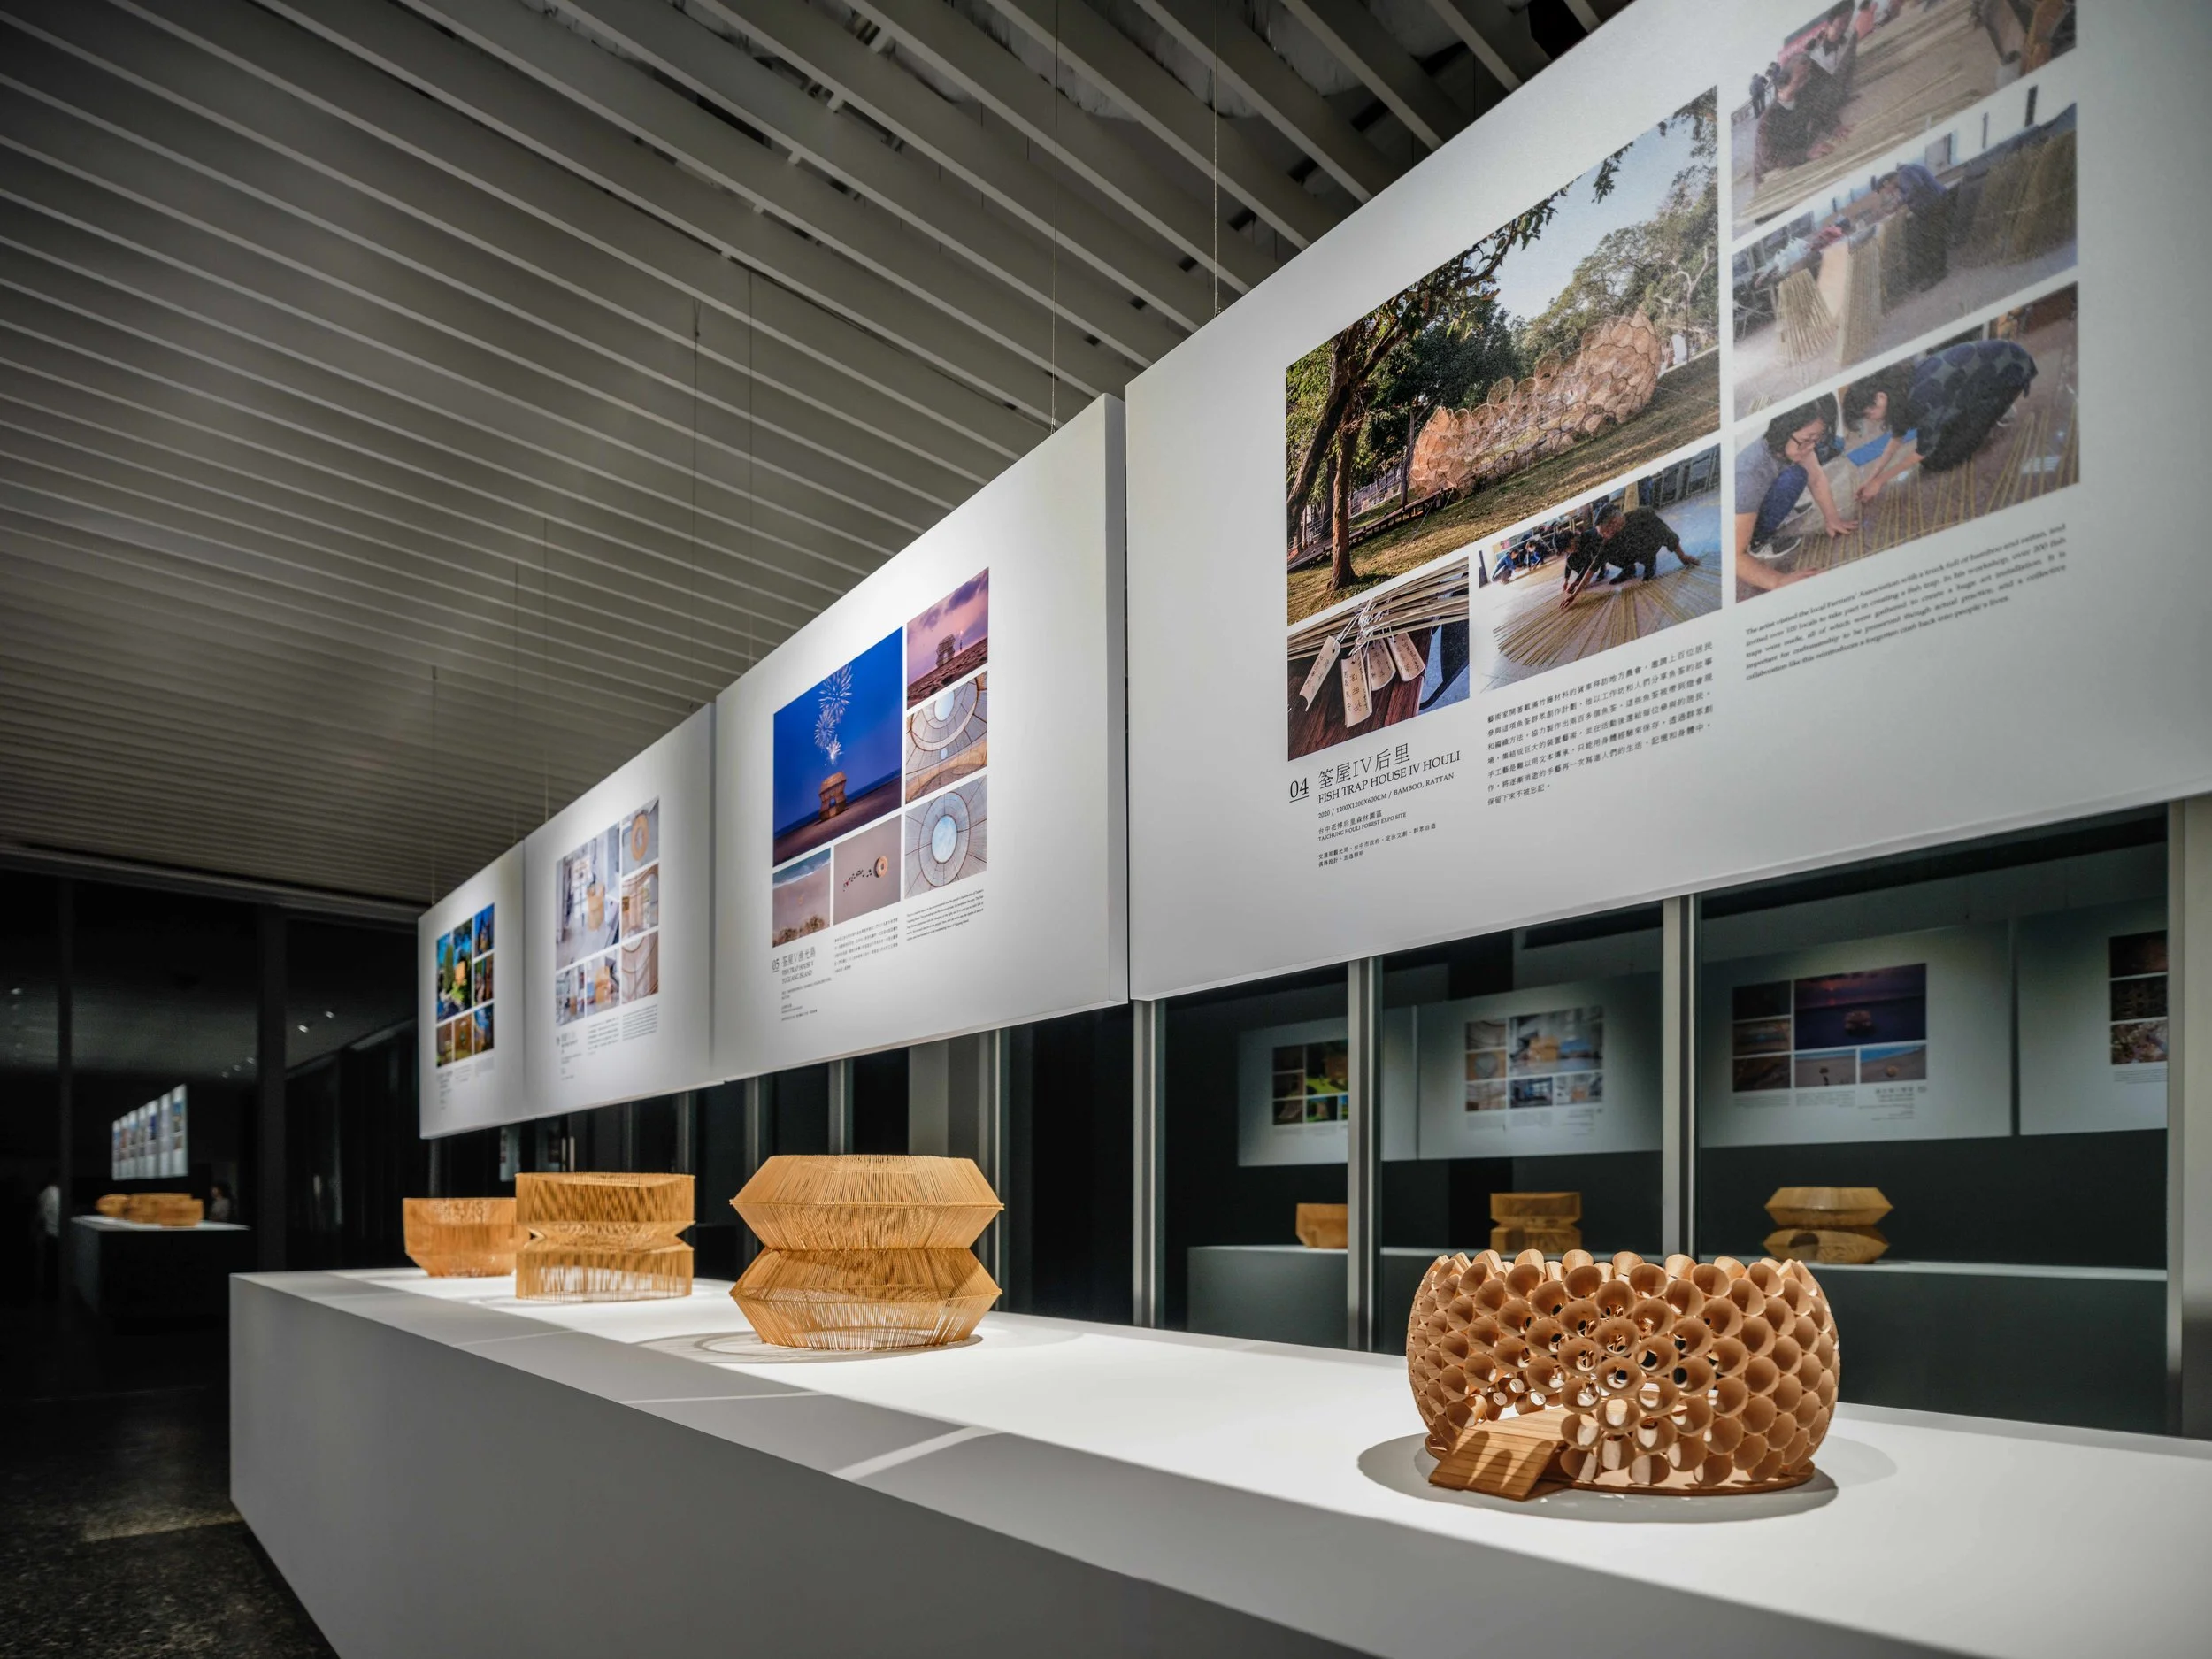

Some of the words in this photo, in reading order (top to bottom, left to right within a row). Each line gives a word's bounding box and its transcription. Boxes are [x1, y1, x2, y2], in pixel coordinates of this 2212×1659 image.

[1901, 573, 1917, 583] with
[1925, 565, 1944, 575] truck
[2003, 540, 2019, 549] and
[2049, 524, 2066, 534] and
[1830, 619, 1850, 630] which
[1855, 614, 1870, 623] were
[1875, 602, 1907, 618] gathered
[1922, 591, 1944, 602] create
[1957, 581, 1976, 590] huge
[1845, 605, 1859, 616] part
[1870, 593, 1899, 605] creating
[1865, 616, 1901, 634] preserved
[1935, 598, 1957, 610] actual
[1999, 580, 2014, 590] and
[2026, 565, 2066, 580] collective
[1866, 630, 1899, 643] forgotten
[1901, 624, 1916, 634] craft
[1918, 618, 1936, 627] back
[1318, 789, 1339, 803] FISH
[1341, 780, 1368, 795] TRAP
[1371, 768, 1406, 787] HOUSE
[1409, 764, 1420, 775] IV
[1424, 751, 1460, 771] HOULI
[1319, 743, 1409, 789] 筌屋IV后里
[1394, 782, 1424, 795] BAMBOO,
[1426, 772, 1454, 786] RATTAN
[1290, 778, 1309, 798] 04
[1318, 830, 1344, 841] TAICHUNG
[1362, 820, 1379, 829] FOREST
